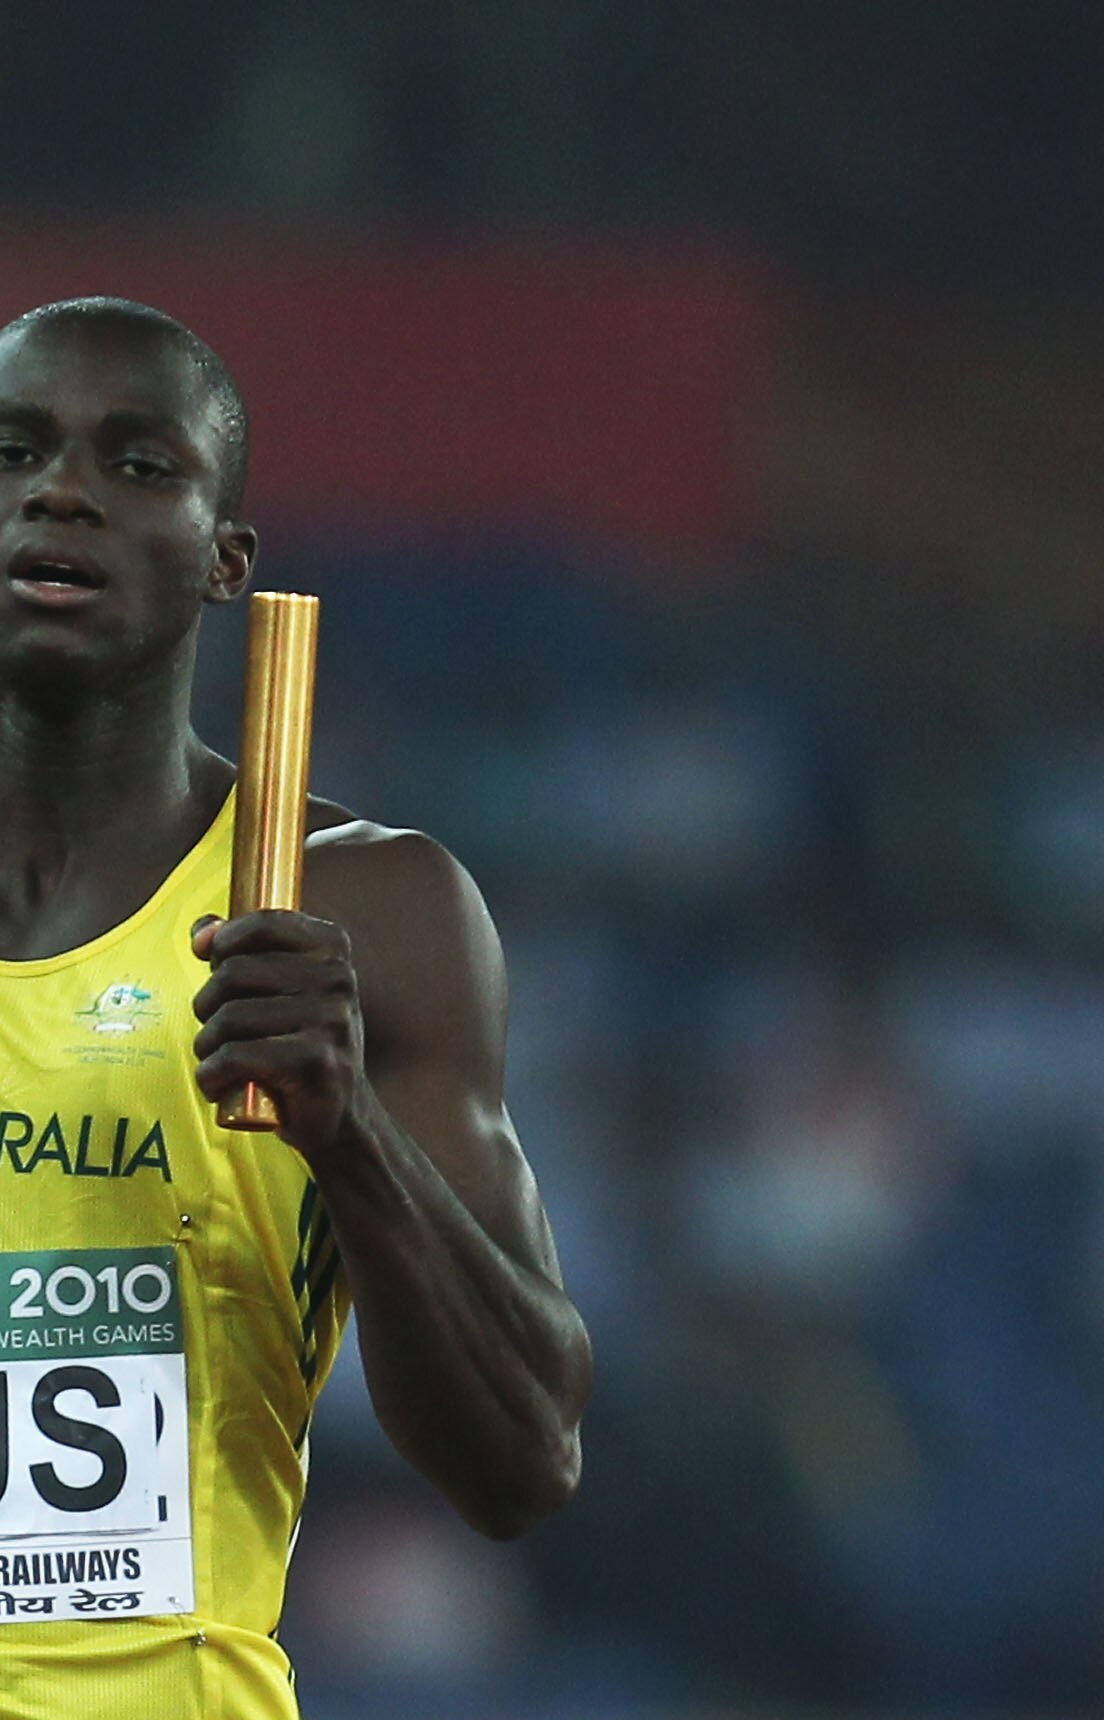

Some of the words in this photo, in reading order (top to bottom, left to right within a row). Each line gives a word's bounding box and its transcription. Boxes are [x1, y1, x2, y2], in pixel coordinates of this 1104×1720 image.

[9, 1264, 172, 1319] 2010
[92, 1322, 176, 1346] GAMES
[69, 1588, 145, 1612] रेल
